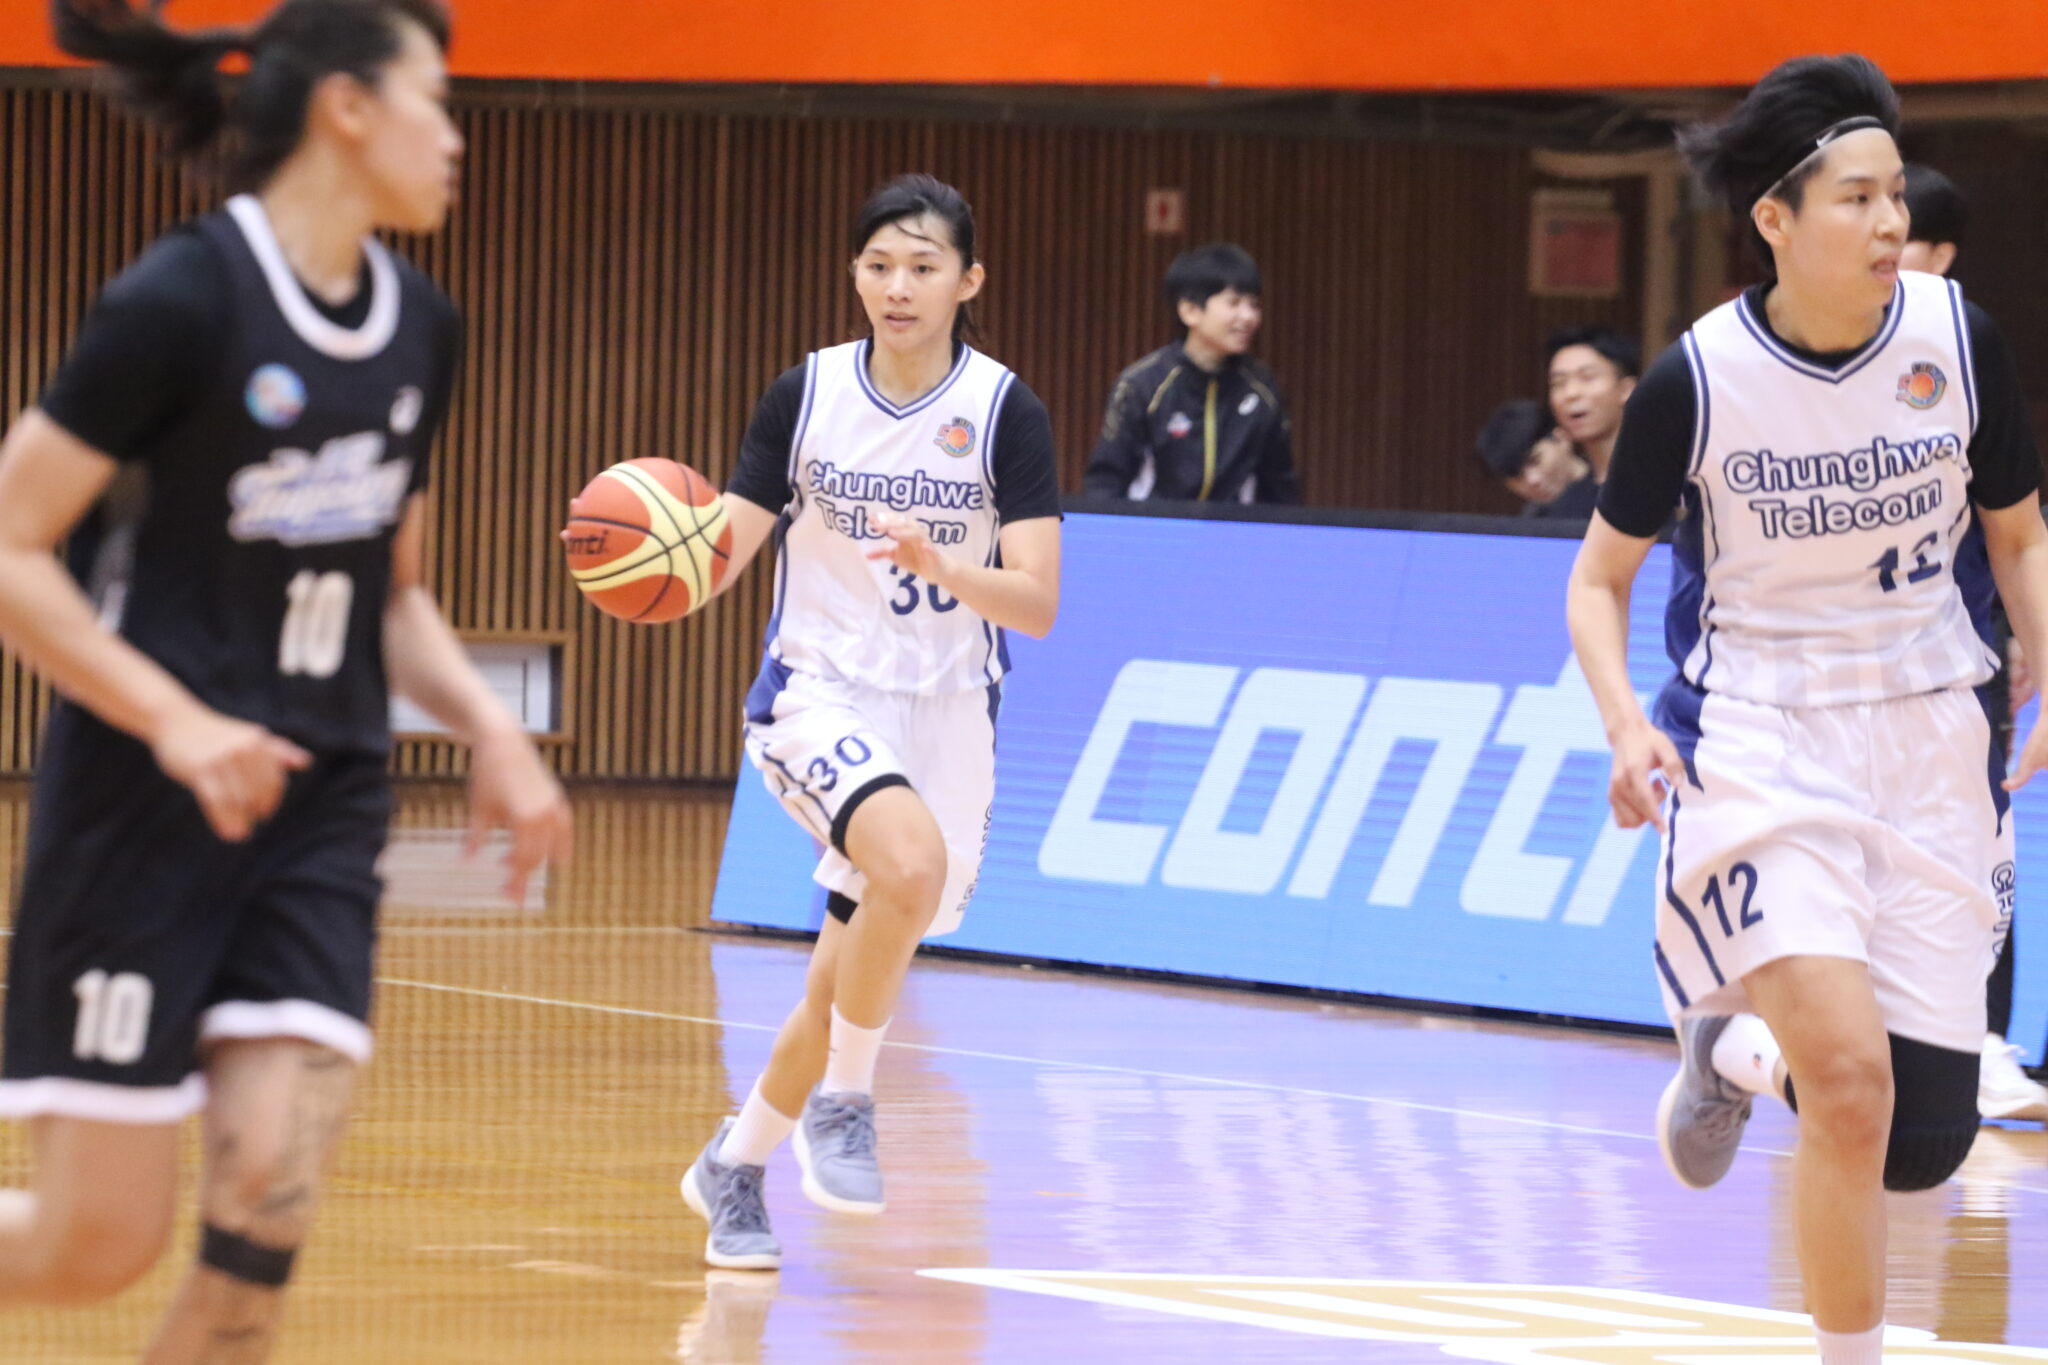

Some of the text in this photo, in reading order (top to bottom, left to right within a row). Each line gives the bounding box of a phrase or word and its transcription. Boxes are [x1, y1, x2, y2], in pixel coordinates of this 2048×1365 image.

[806, 459, 984, 512] Chunghwa
[1723, 432, 1961, 494] Chunghwa
[815, 497, 967, 545] Telem
[1749, 479, 1941, 539] Telecom
[278, 569, 354, 679] 10
[808, 736, 872, 792] 30
[1701, 861, 1764, 938] 12
[73, 968, 153, 1064] 10
